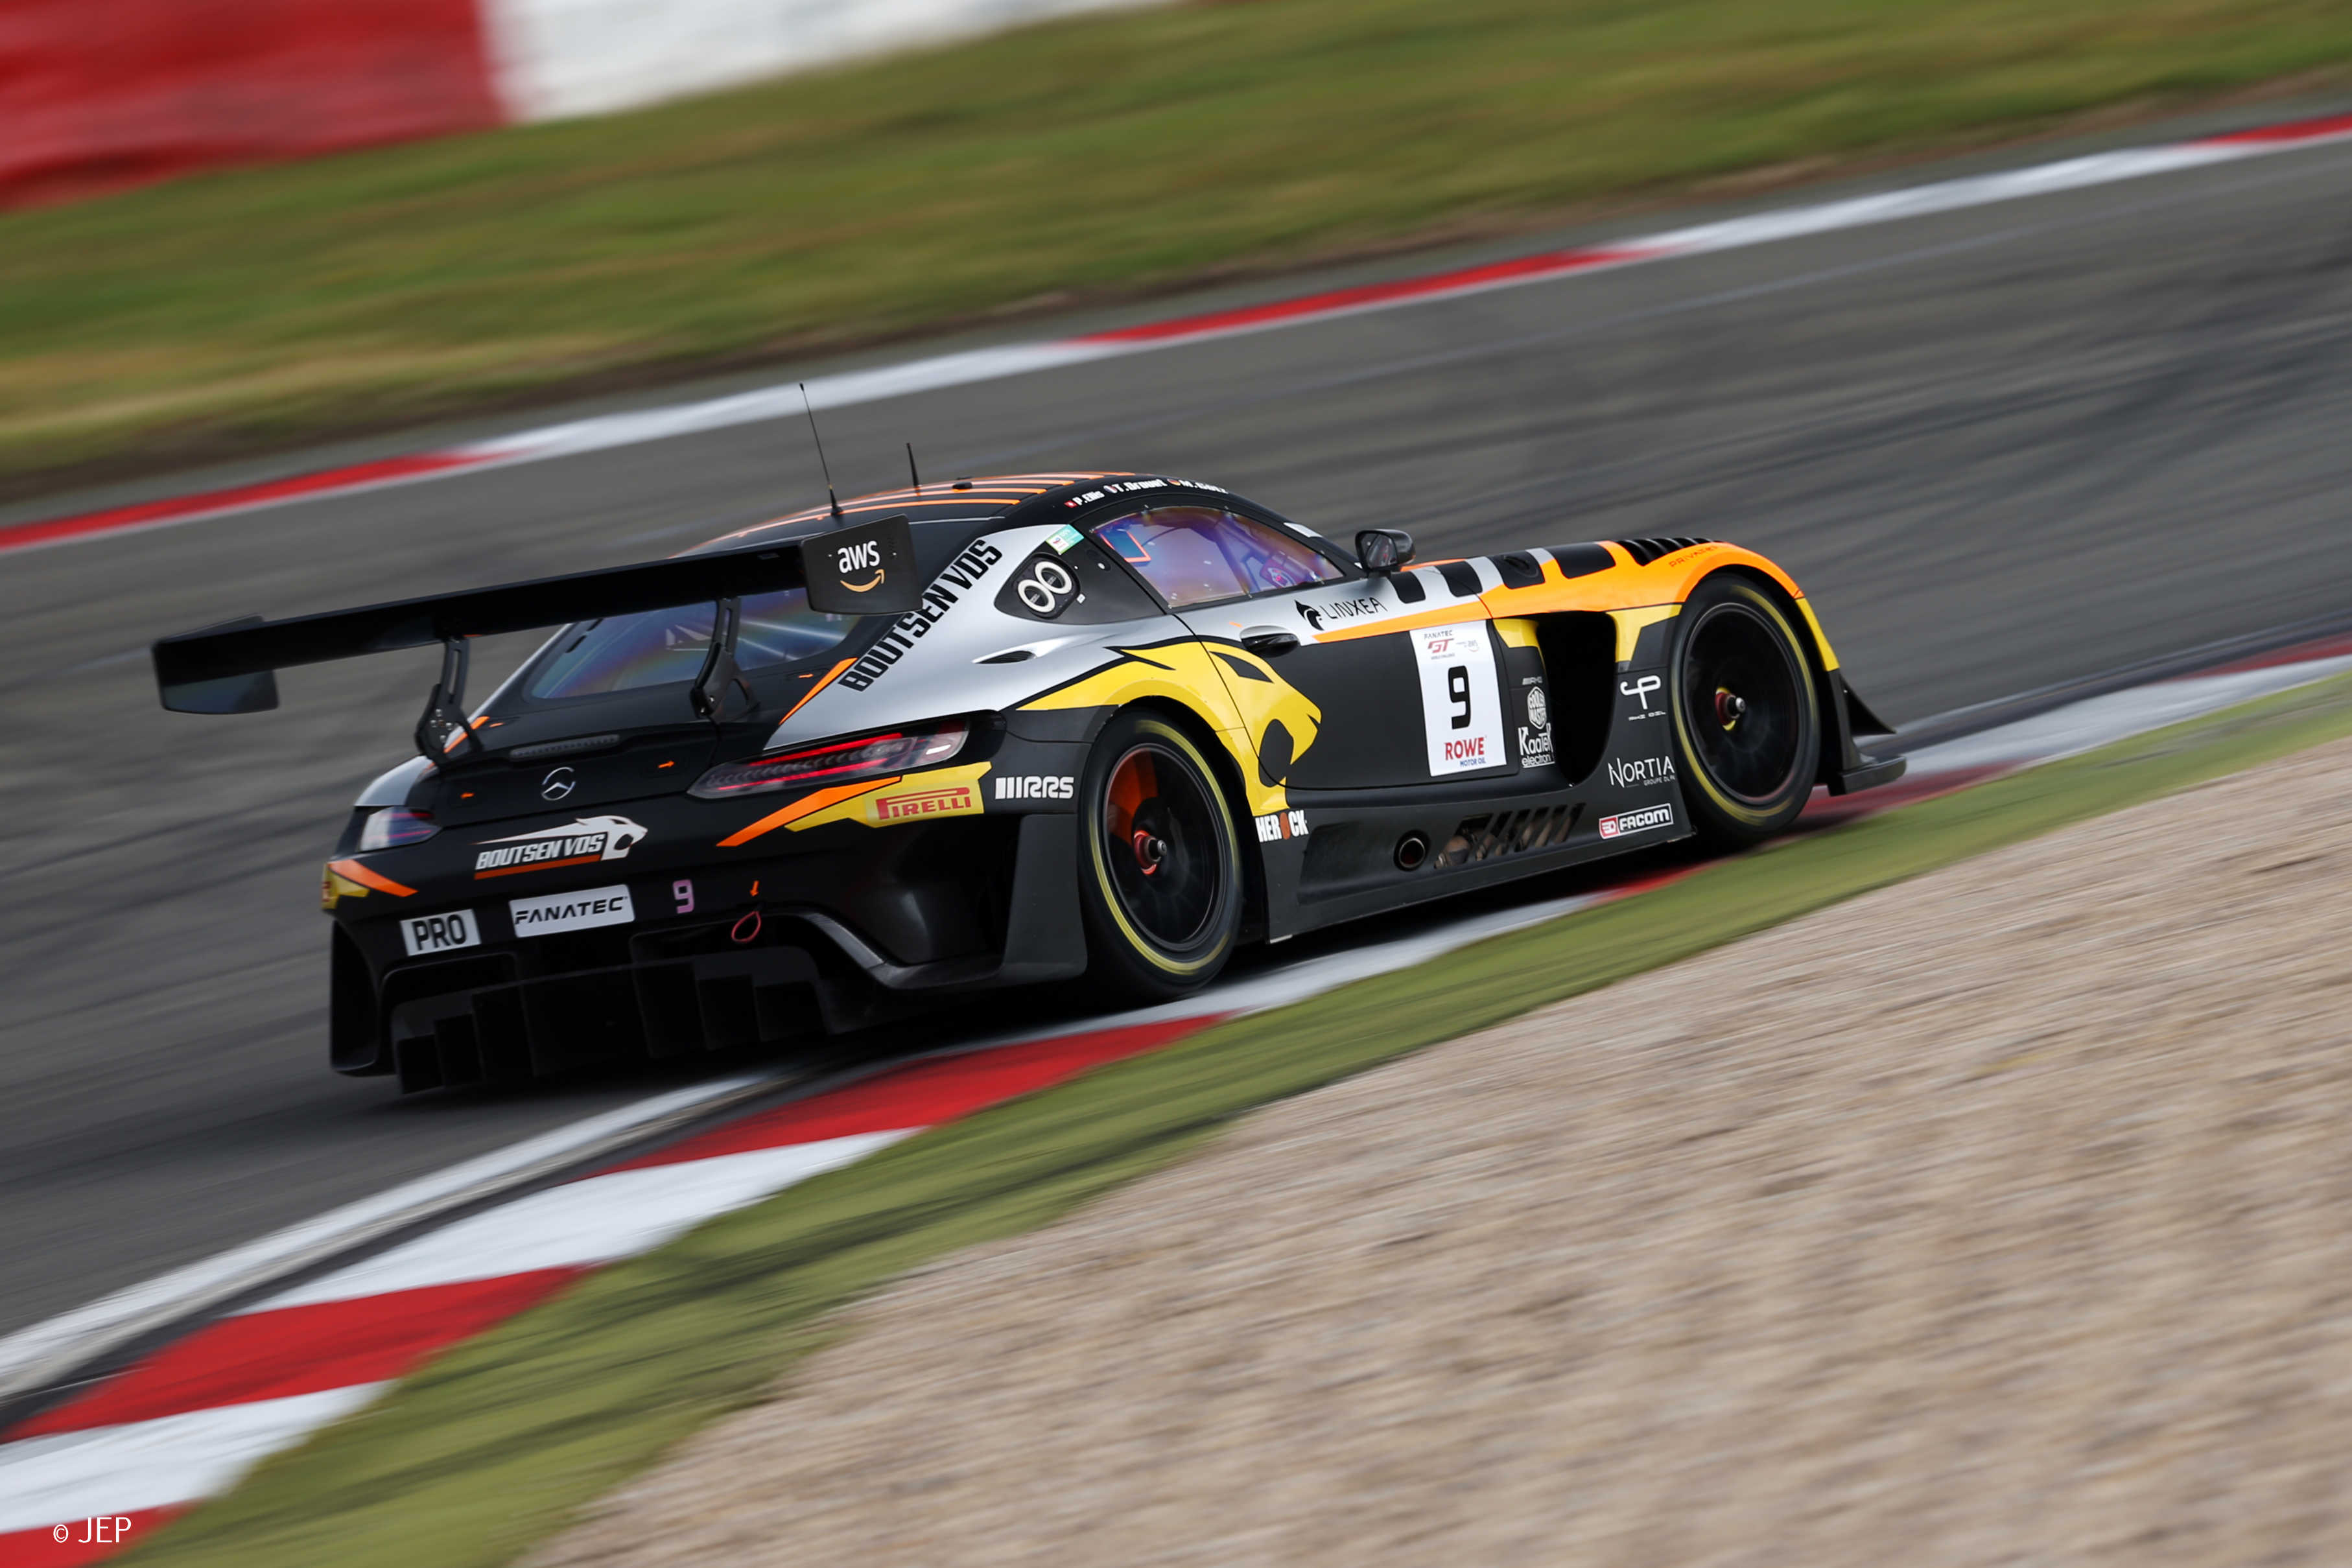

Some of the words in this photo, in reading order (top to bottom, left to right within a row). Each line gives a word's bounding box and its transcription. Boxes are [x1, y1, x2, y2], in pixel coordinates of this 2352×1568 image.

[837, 540, 880, 574] aws
[838, 583, 959, 692] BOUTSEN
[940, 539, 1003, 590] VDS
[1319, 596, 1388, 619] LINXEA
[1424, 629, 1453, 640] FANATEC
[1448, 665, 1472, 730] 9
[1444, 737, 1485, 761] ROWE
[1460, 758, 1477, 767] MOTOR
[1608, 756, 1675, 788] NORTIA
[876, 787, 971, 821] PIRELLI
[1619, 808, 1670, 831] FACOM
[475, 839, 563, 870] BOUTSEN
[563, 834, 606, 856] VDS
[515, 896, 624, 925] FANATEC
[673, 879, 694, 914] 9
[412, 914, 467, 951] PRO
